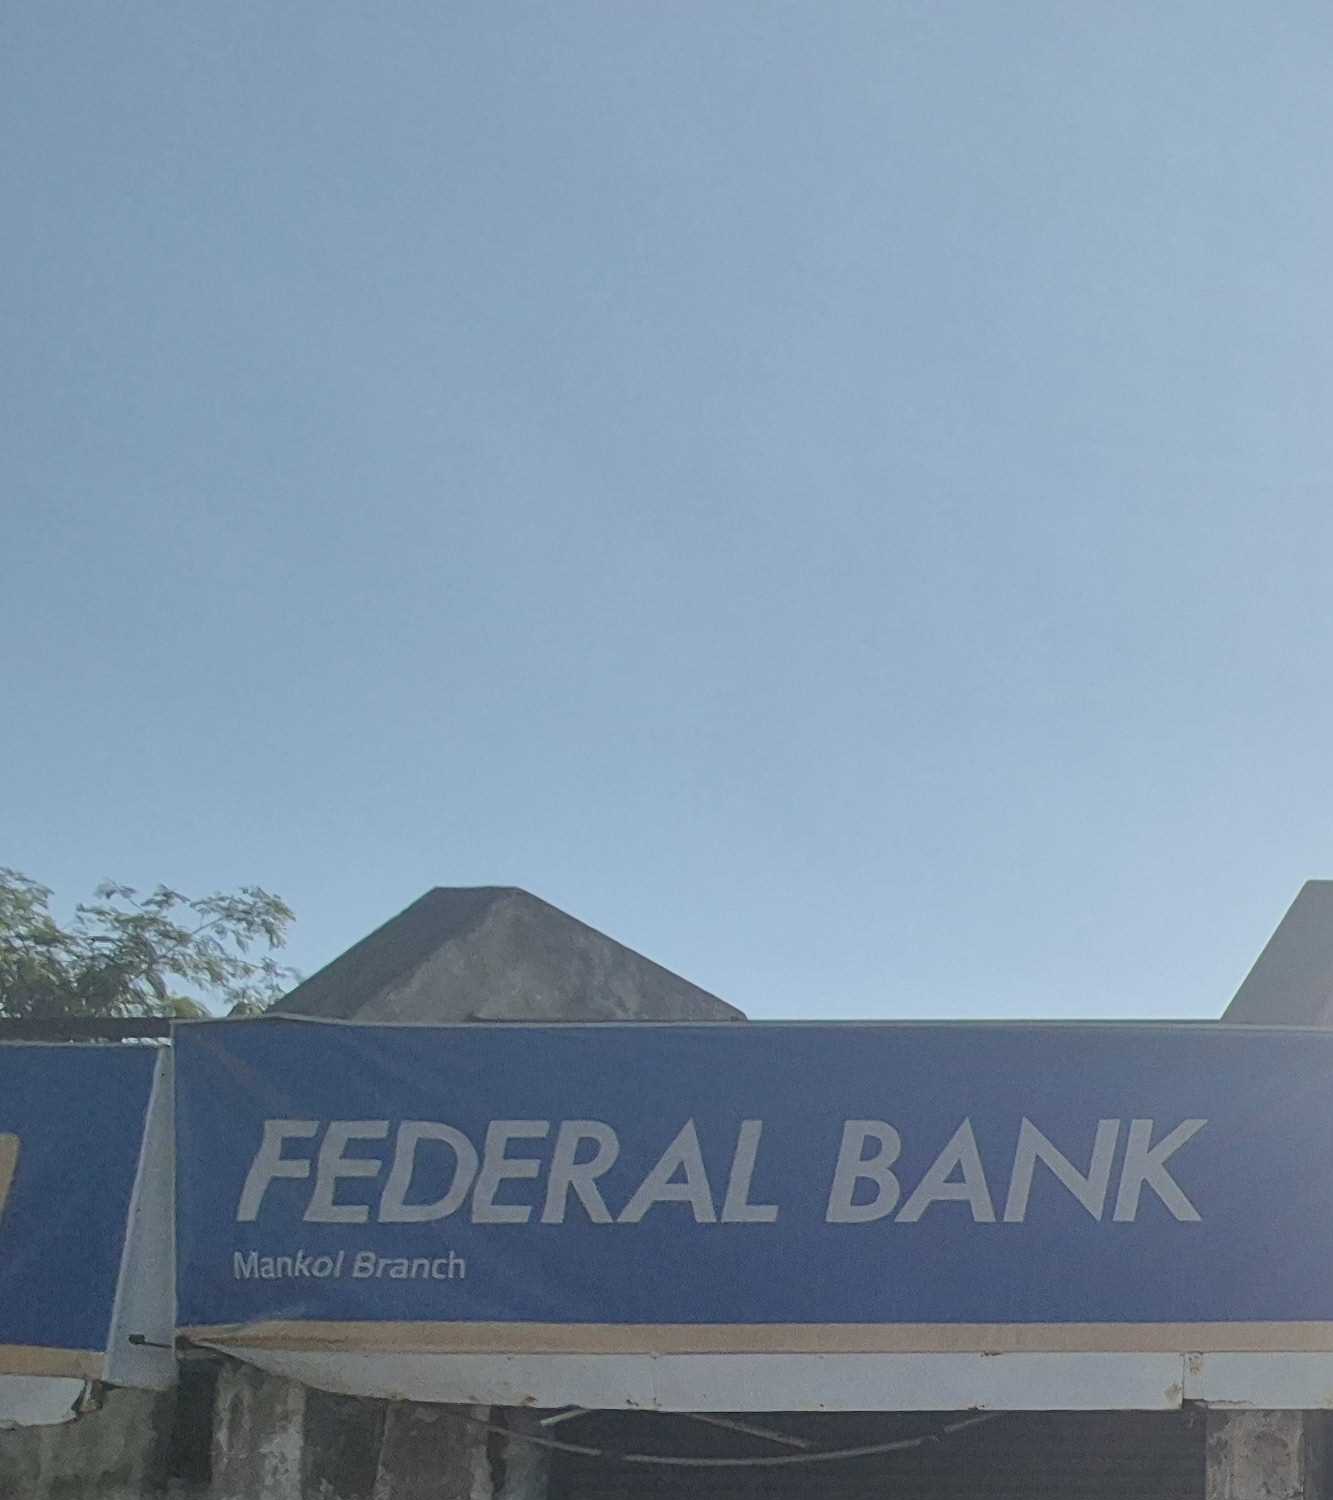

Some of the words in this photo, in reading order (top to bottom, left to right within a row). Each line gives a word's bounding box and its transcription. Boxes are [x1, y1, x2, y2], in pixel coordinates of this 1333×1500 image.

[235, 1118, 780, 1226] FEDERAL
[825, 1117, 1209, 1224] BANK
[232, 1250, 345, 1280] Mankol
[351, 1250, 466, 1280] Branch
